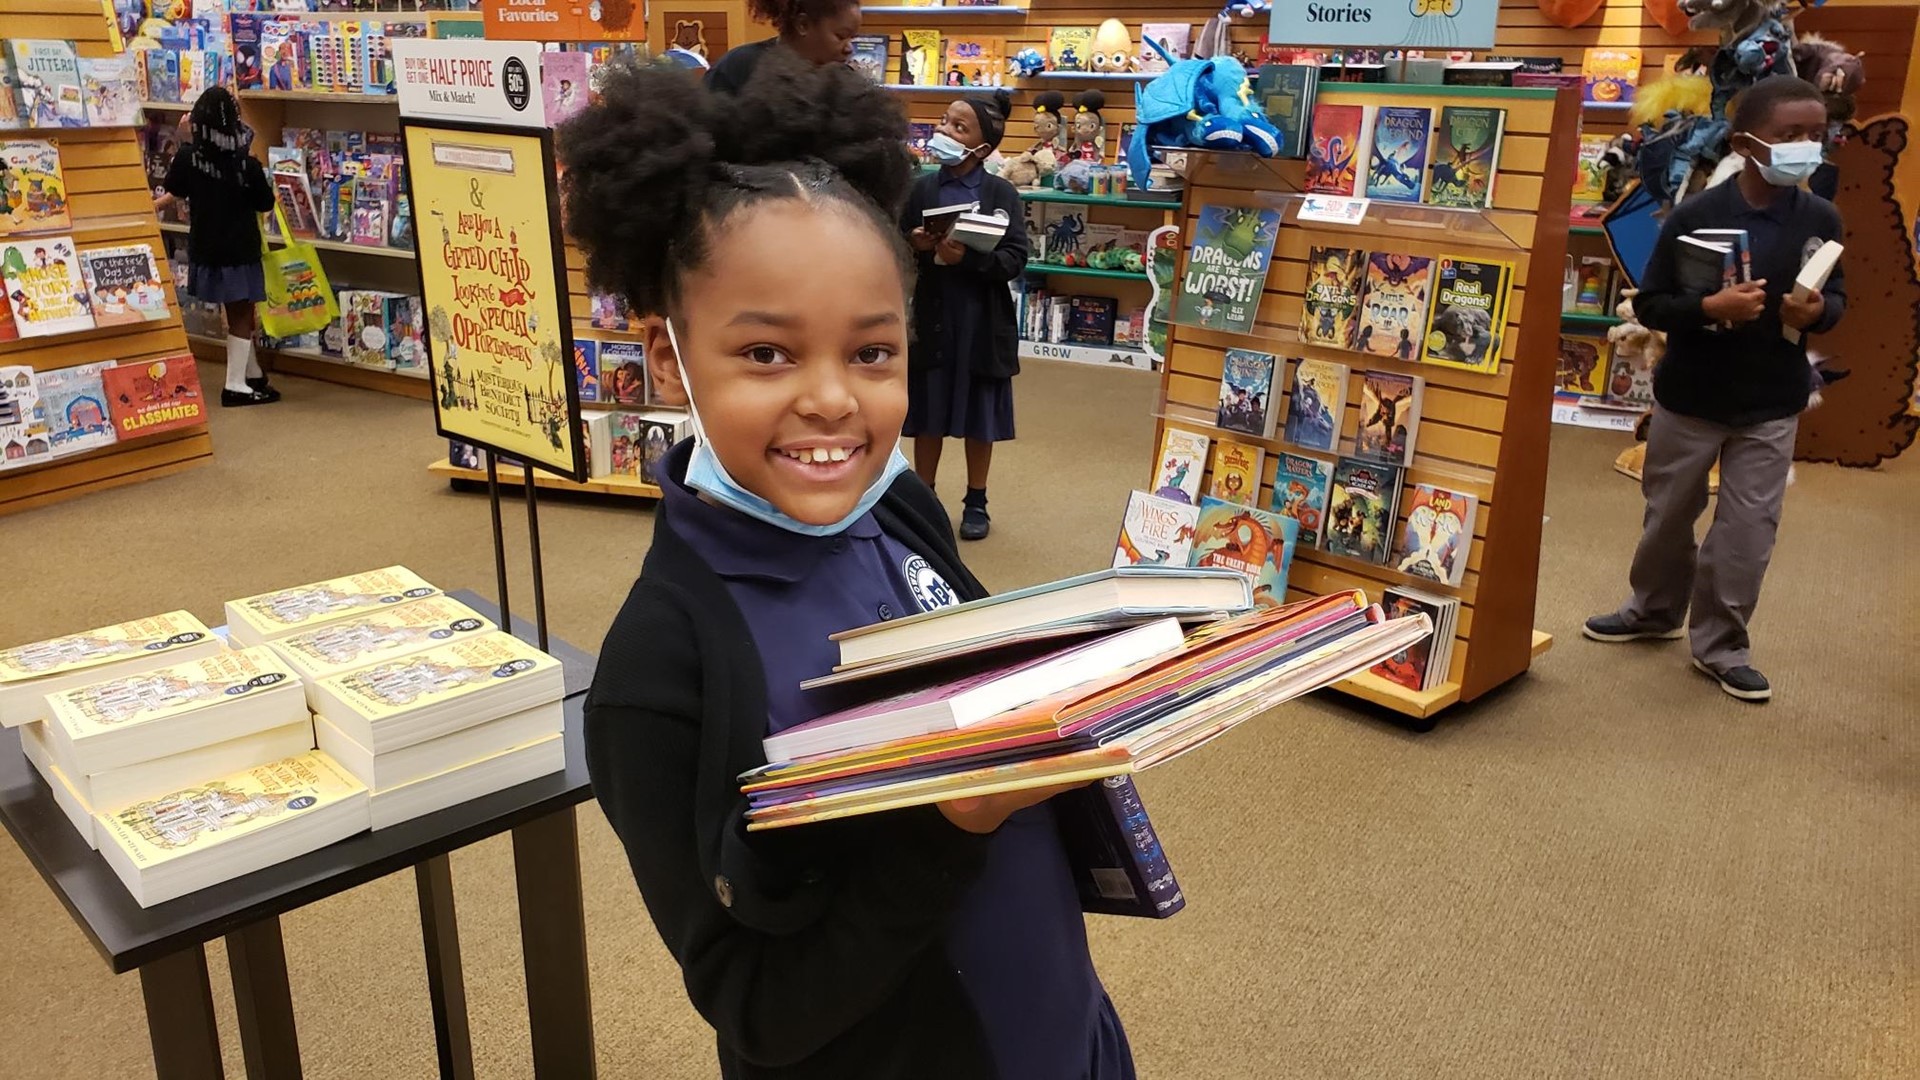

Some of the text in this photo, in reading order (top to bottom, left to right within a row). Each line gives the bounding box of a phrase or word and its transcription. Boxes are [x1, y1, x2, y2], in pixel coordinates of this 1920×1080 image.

[498, 8, 559, 22] Favorites
[1306, 3, 1372, 23] Stories
[28, 58, 74, 72] JITTERS
[405, 57, 428, 70] BUY ONE
[407, 71, 429, 84] GET ONE
[429, 58, 494, 87] HALF PRICE
[428, 90, 476, 104] Mix & Match!
[1384, 116, 1424, 128] DRAGON
[470, 177, 485, 210] &
[94, 259, 107, 270] On
[109, 257, 124, 268] the
[1206, 265, 1241, 276] ARE THE
[104, 268, 121, 278] Day
[1185, 272, 1255, 302] WORST!
[1316, 284, 1348, 296] BATTLE
[1455, 281, 1479, 294] Real
[1306, 289, 1357, 306] DRAGONS
[1442, 291, 1489, 307] Dragons!
[1033, 345, 1072, 359] GROW
[122, 404, 199, 431] CLASSMATES
[485, 400, 520, 426] SOCIETY
[1429, 495, 1452, 510] LAND
[1140, 500, 1179, 525] WINGS
[1141, 520, 1168, 540] FIRE
[1213, 552, 1225, 564] THE
[1225, 557, 1245, 569] GREAT
